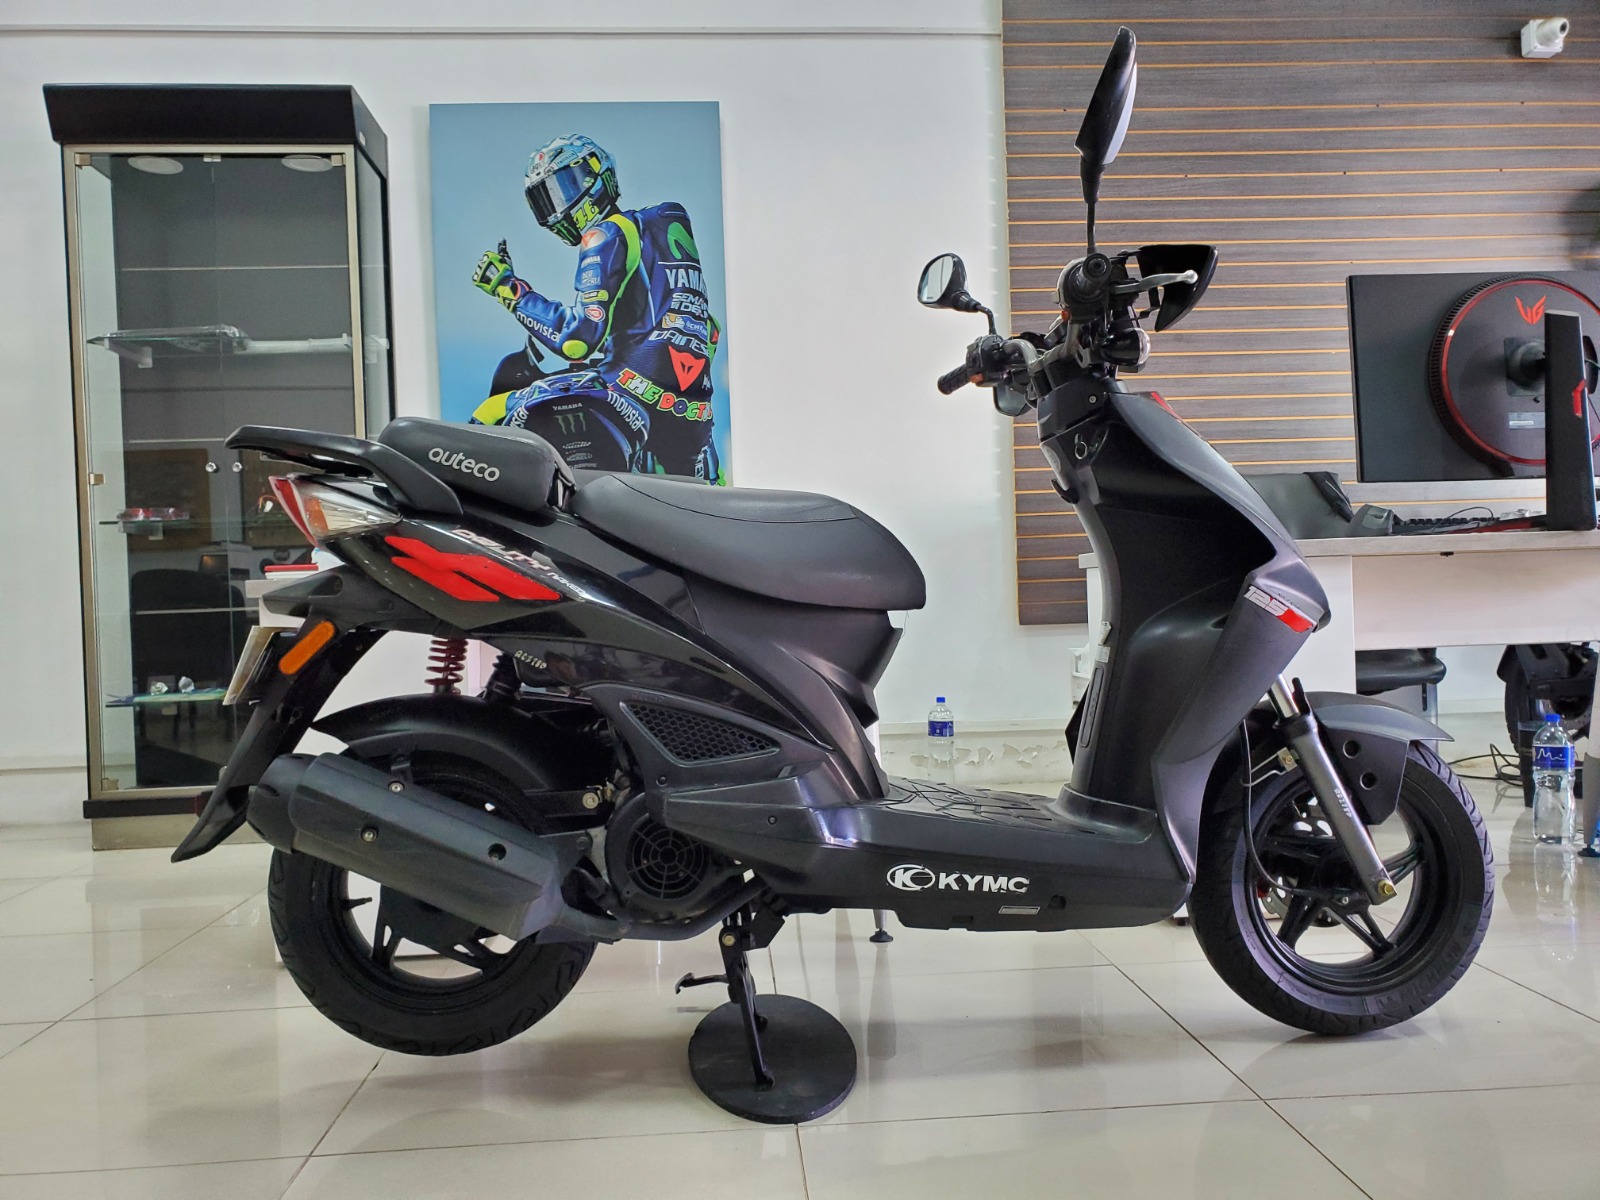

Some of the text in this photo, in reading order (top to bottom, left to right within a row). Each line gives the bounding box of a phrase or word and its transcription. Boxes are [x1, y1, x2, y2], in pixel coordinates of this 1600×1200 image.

[573, 197, 600, 232] 46
[616, 368, 664, 404] THE
[607, 391, 645, 432] movistar
[428, 447, 500, 482] auteco
[1243, 585, 1290, 617] 125
[938, 871, 1030, 893] KYMC
